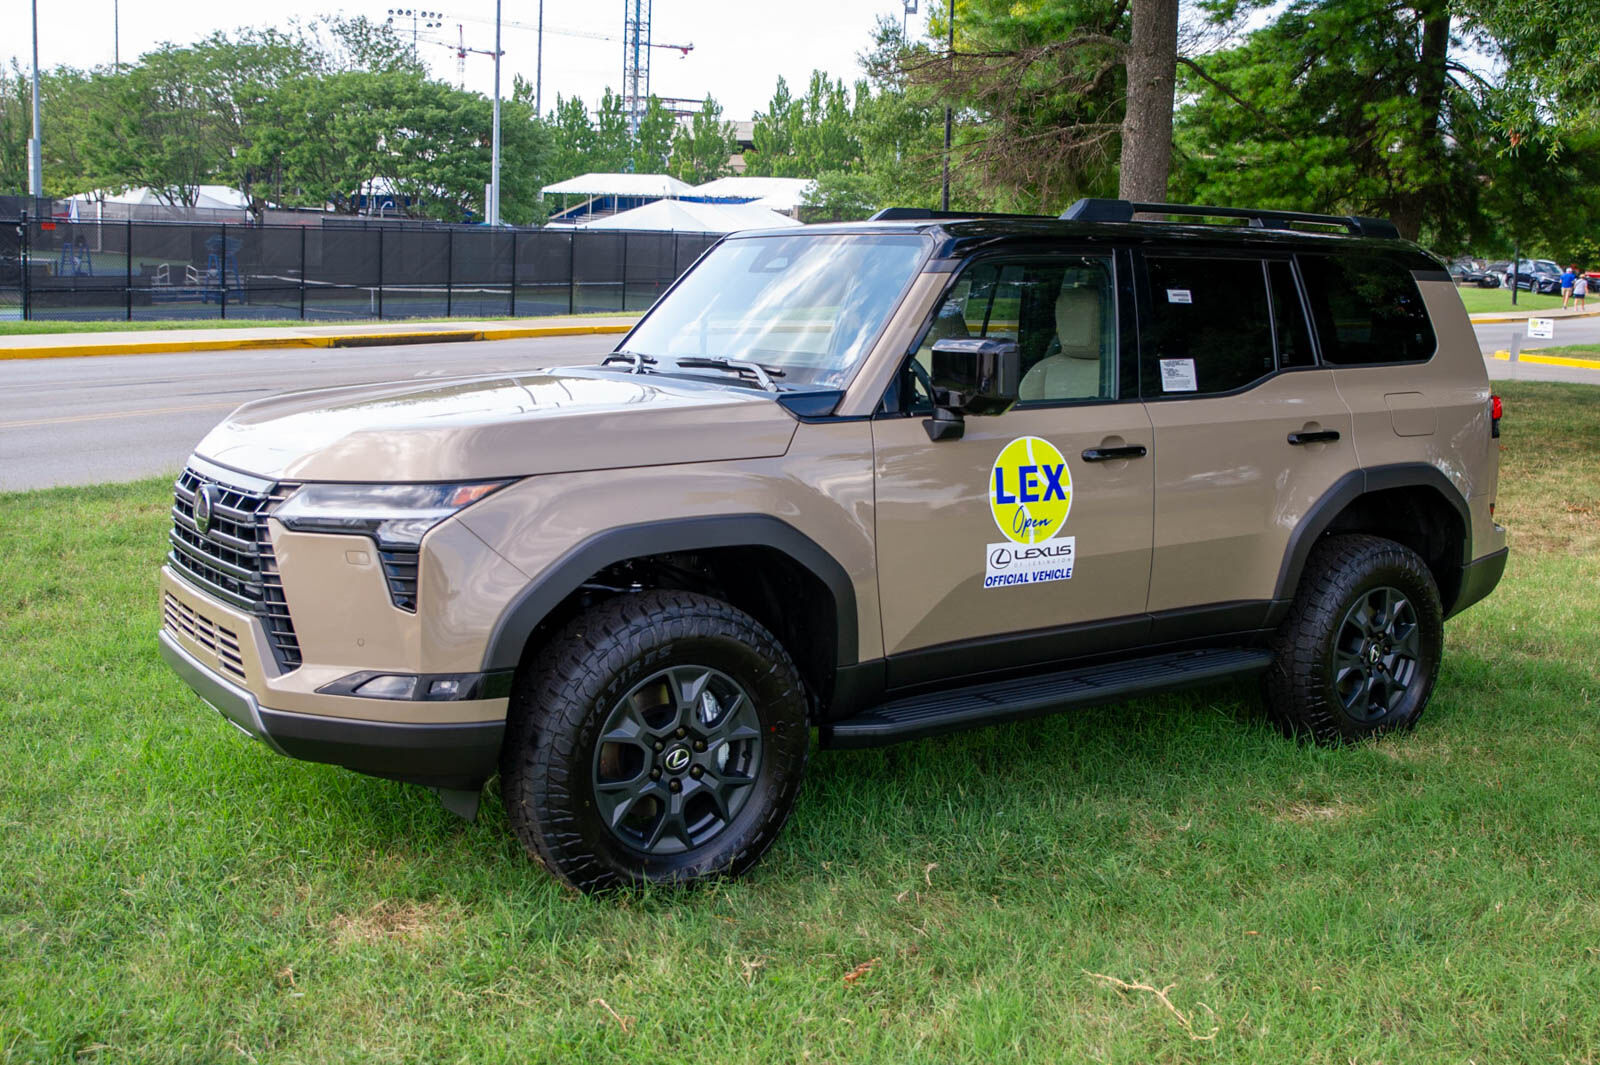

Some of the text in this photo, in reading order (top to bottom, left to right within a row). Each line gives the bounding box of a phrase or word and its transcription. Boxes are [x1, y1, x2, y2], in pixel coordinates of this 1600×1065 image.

[995, 464, 1066, 504] LEX
[1012, 505, 1052, 537] Open
[1014, 545, 1071, 559] LEXUS
[985, 568, 1072, 587] OFFICIAL VEHICLE
